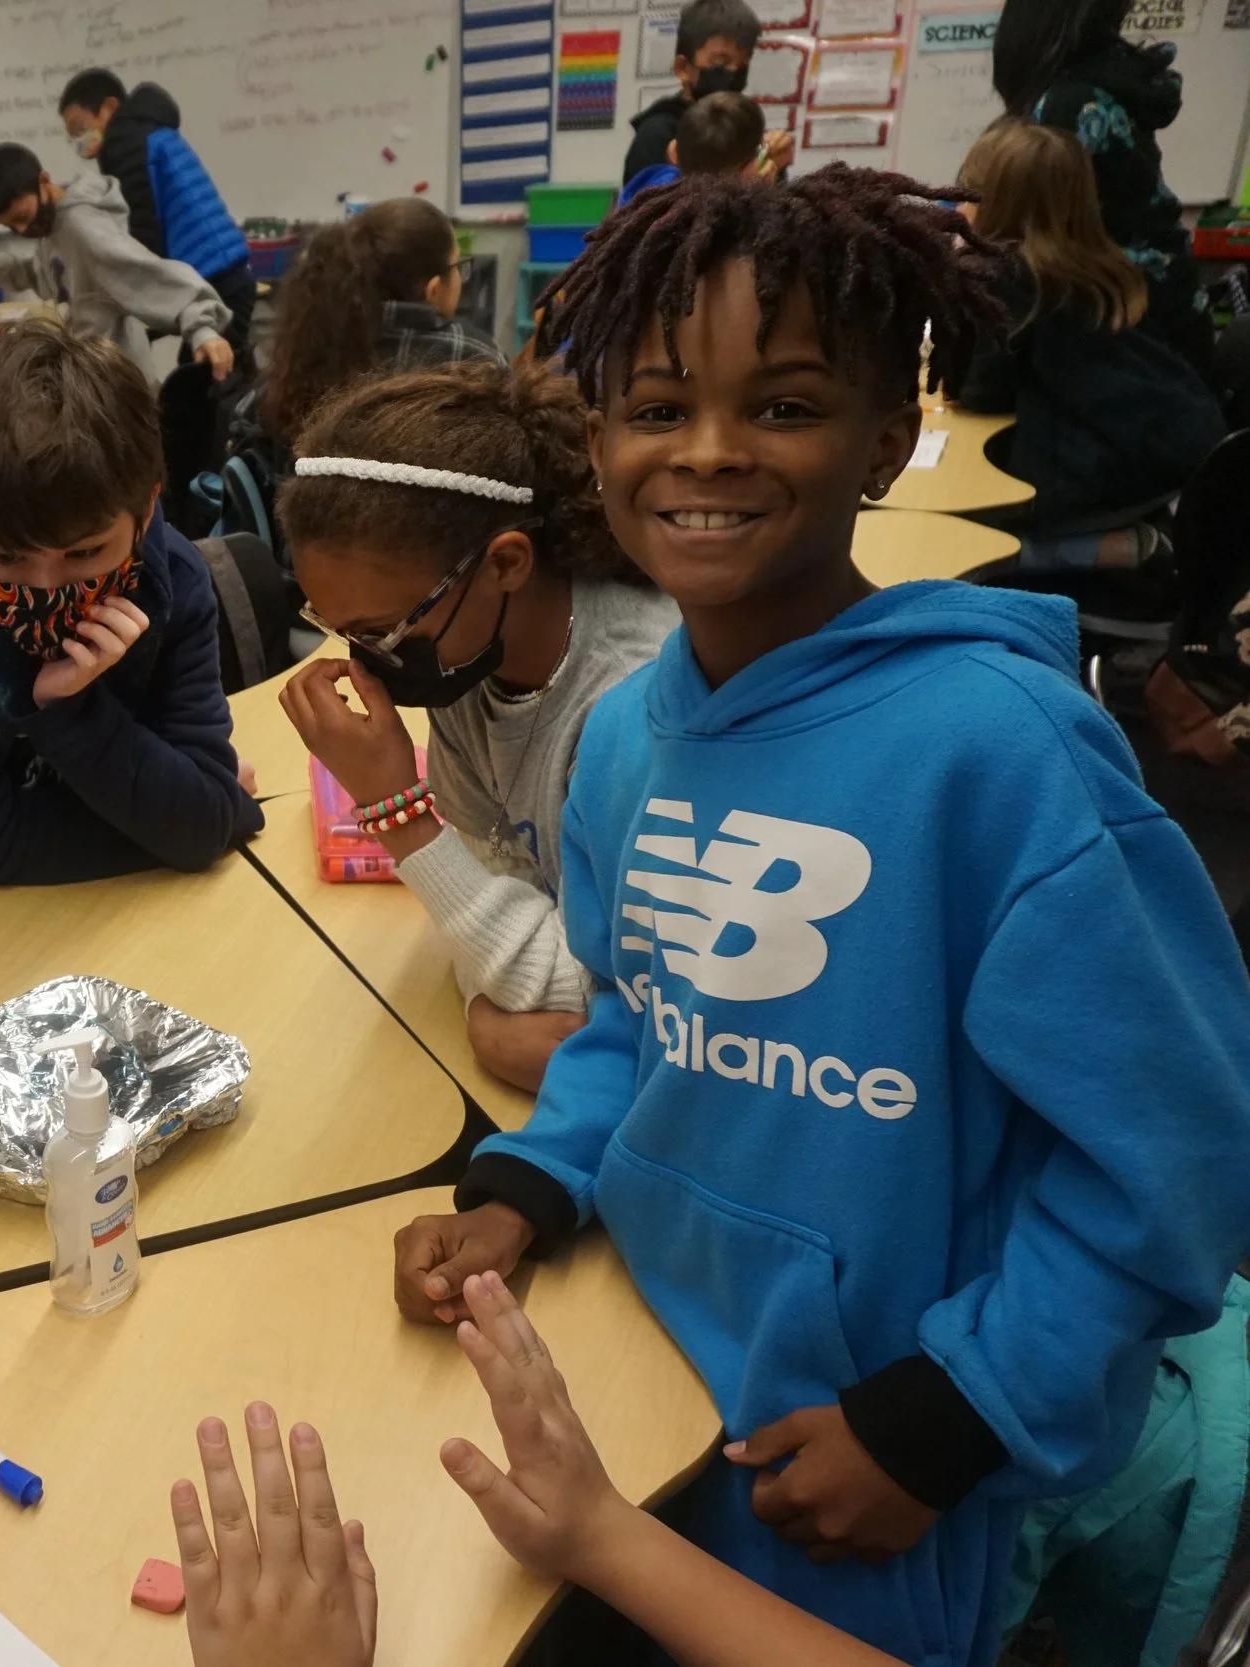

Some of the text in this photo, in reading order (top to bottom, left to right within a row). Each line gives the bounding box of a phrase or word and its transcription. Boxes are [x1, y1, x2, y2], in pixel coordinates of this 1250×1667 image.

[925, 22, 997, 42] SCIENC
[1124, 15, 1184, 30] TUDIES
[652, 985, 918, 1121] balance
